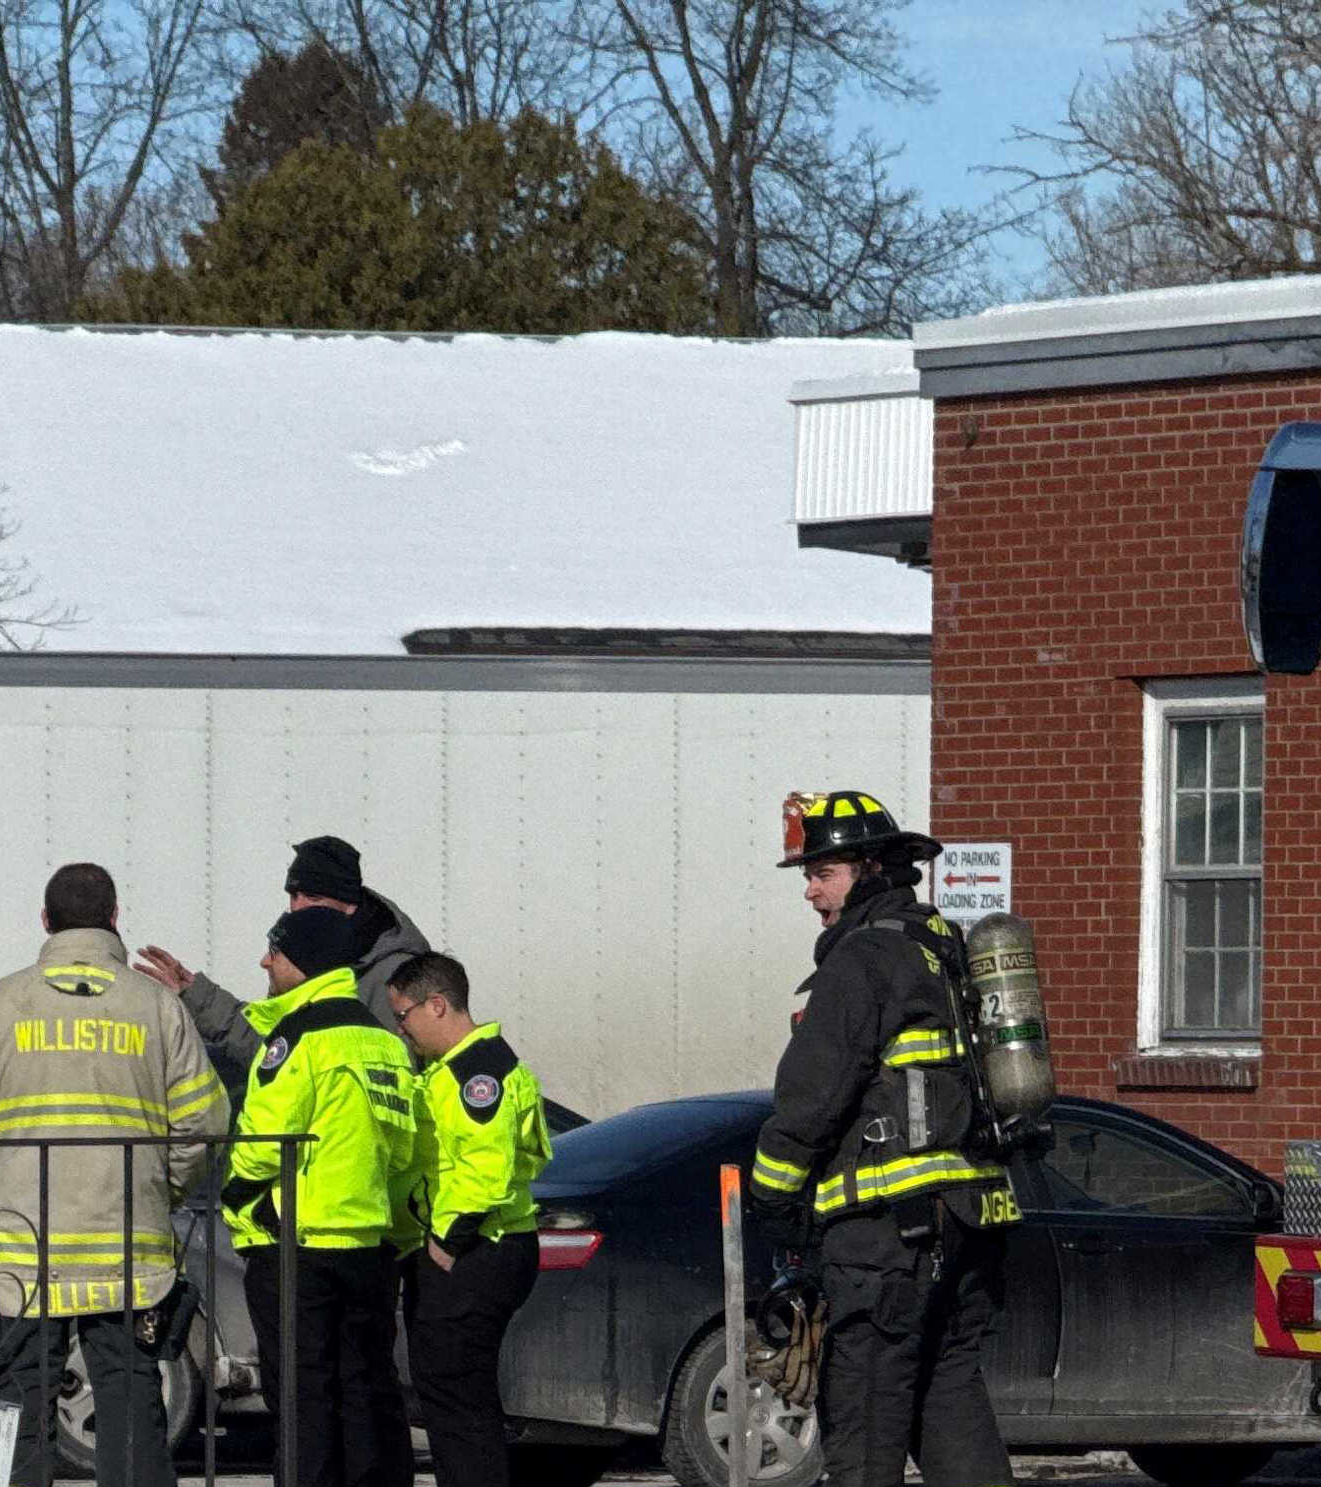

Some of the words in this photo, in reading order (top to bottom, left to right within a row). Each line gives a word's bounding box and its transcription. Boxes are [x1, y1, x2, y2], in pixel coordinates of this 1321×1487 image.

[944, 851, 958, 867] NO
[960, 851, 1001, 867] PARKING
[938, 893, 978, 909] LOADING
[979, 893, 1005, 909] ZONE
[14, 1017, 147, 1057] WILLISTON
